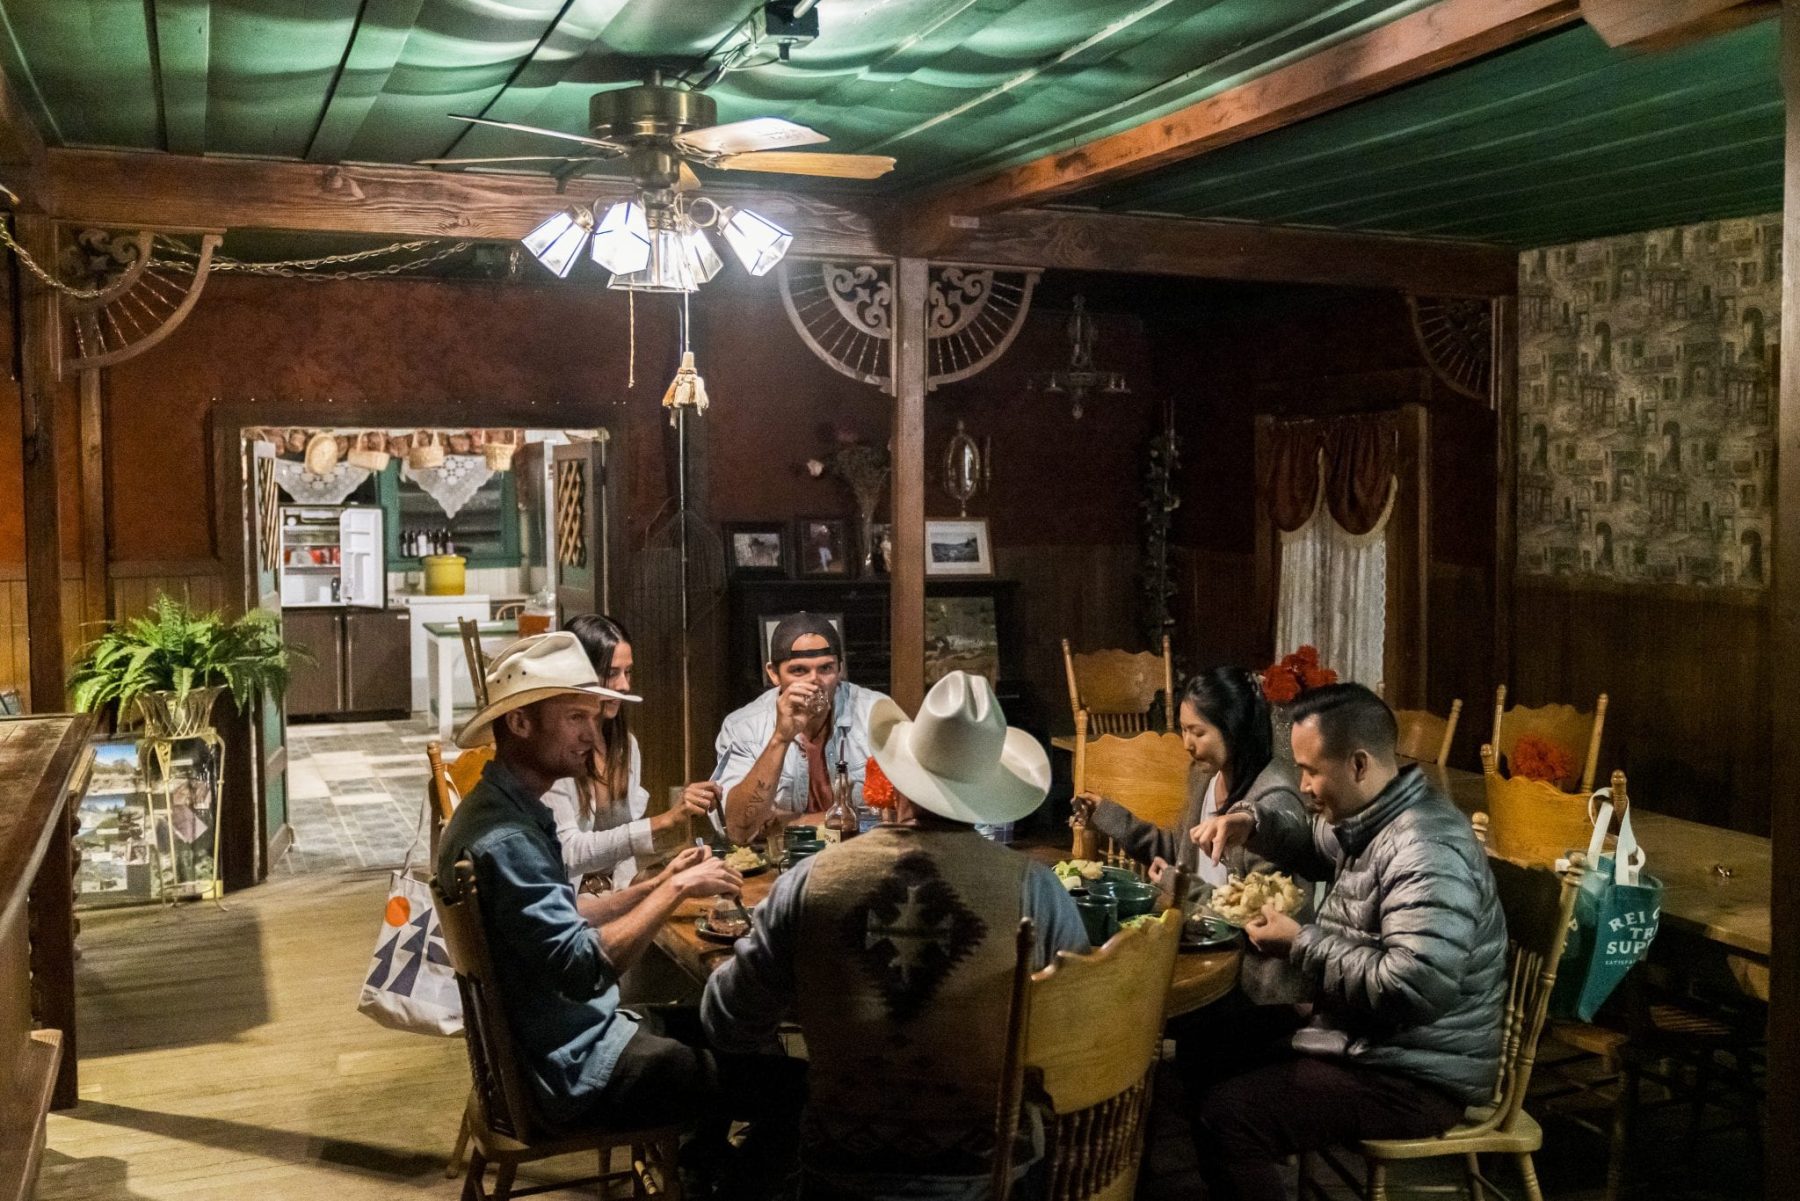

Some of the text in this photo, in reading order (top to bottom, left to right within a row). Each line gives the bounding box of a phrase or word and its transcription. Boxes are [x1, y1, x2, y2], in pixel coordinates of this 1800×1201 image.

[1608, 911, 1646, 932] REI
[1629, 926, 1656, 940] TR
[1606, 941, 1650, 955] SUP
